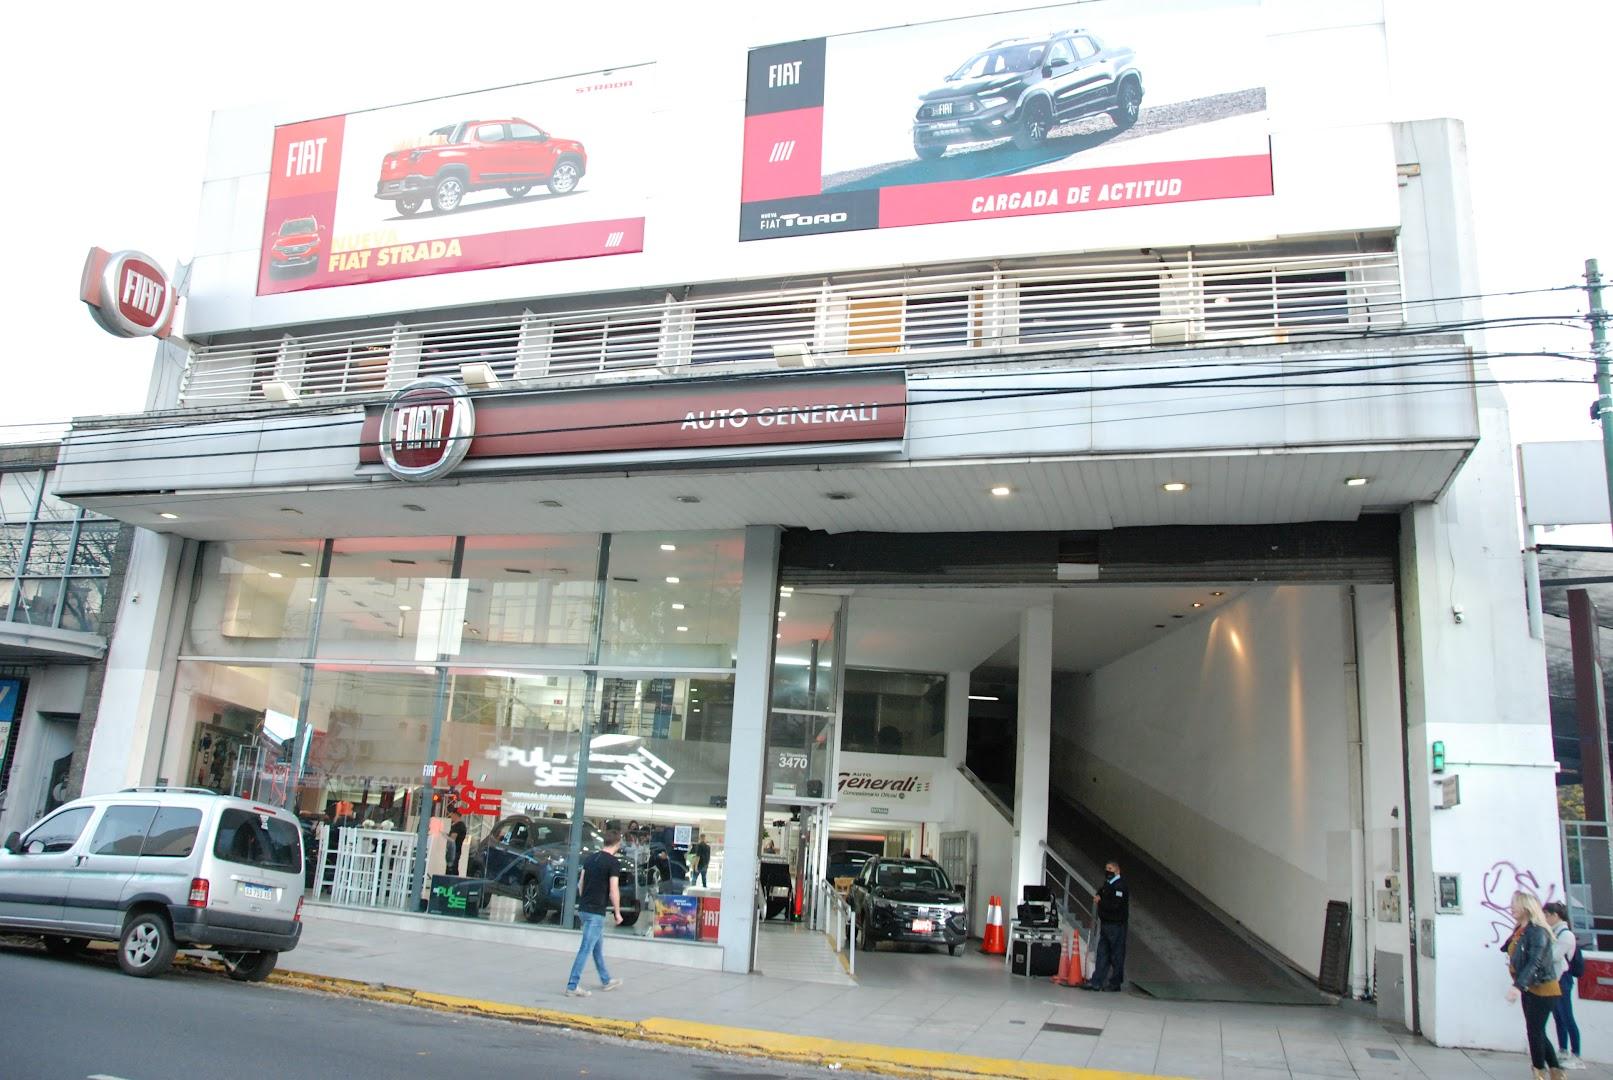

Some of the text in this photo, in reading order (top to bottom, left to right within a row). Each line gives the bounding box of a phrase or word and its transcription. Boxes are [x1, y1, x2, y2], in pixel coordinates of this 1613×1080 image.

[768, 61, 803, 88] FIAT
[285, 137, 328, 178] FIAT
[971, 178, 1183, 214] CARGADA DE ACTITUD
[760, 212, 848, 230] FIAT TORO
[331, 229, 399, 254] NUEVA
[328, 239, 462, 273] FIAT STRADA
[122, 268, 164, 318] FIAT
[395, 404, 450, 451] FIAT
[681, 401, 879, 431] AUTO GENERALI
[422, 764, 437, 777] FIAT
[778, 757, 808, 769] 3470
[703, 910, 720, 927] IAT
